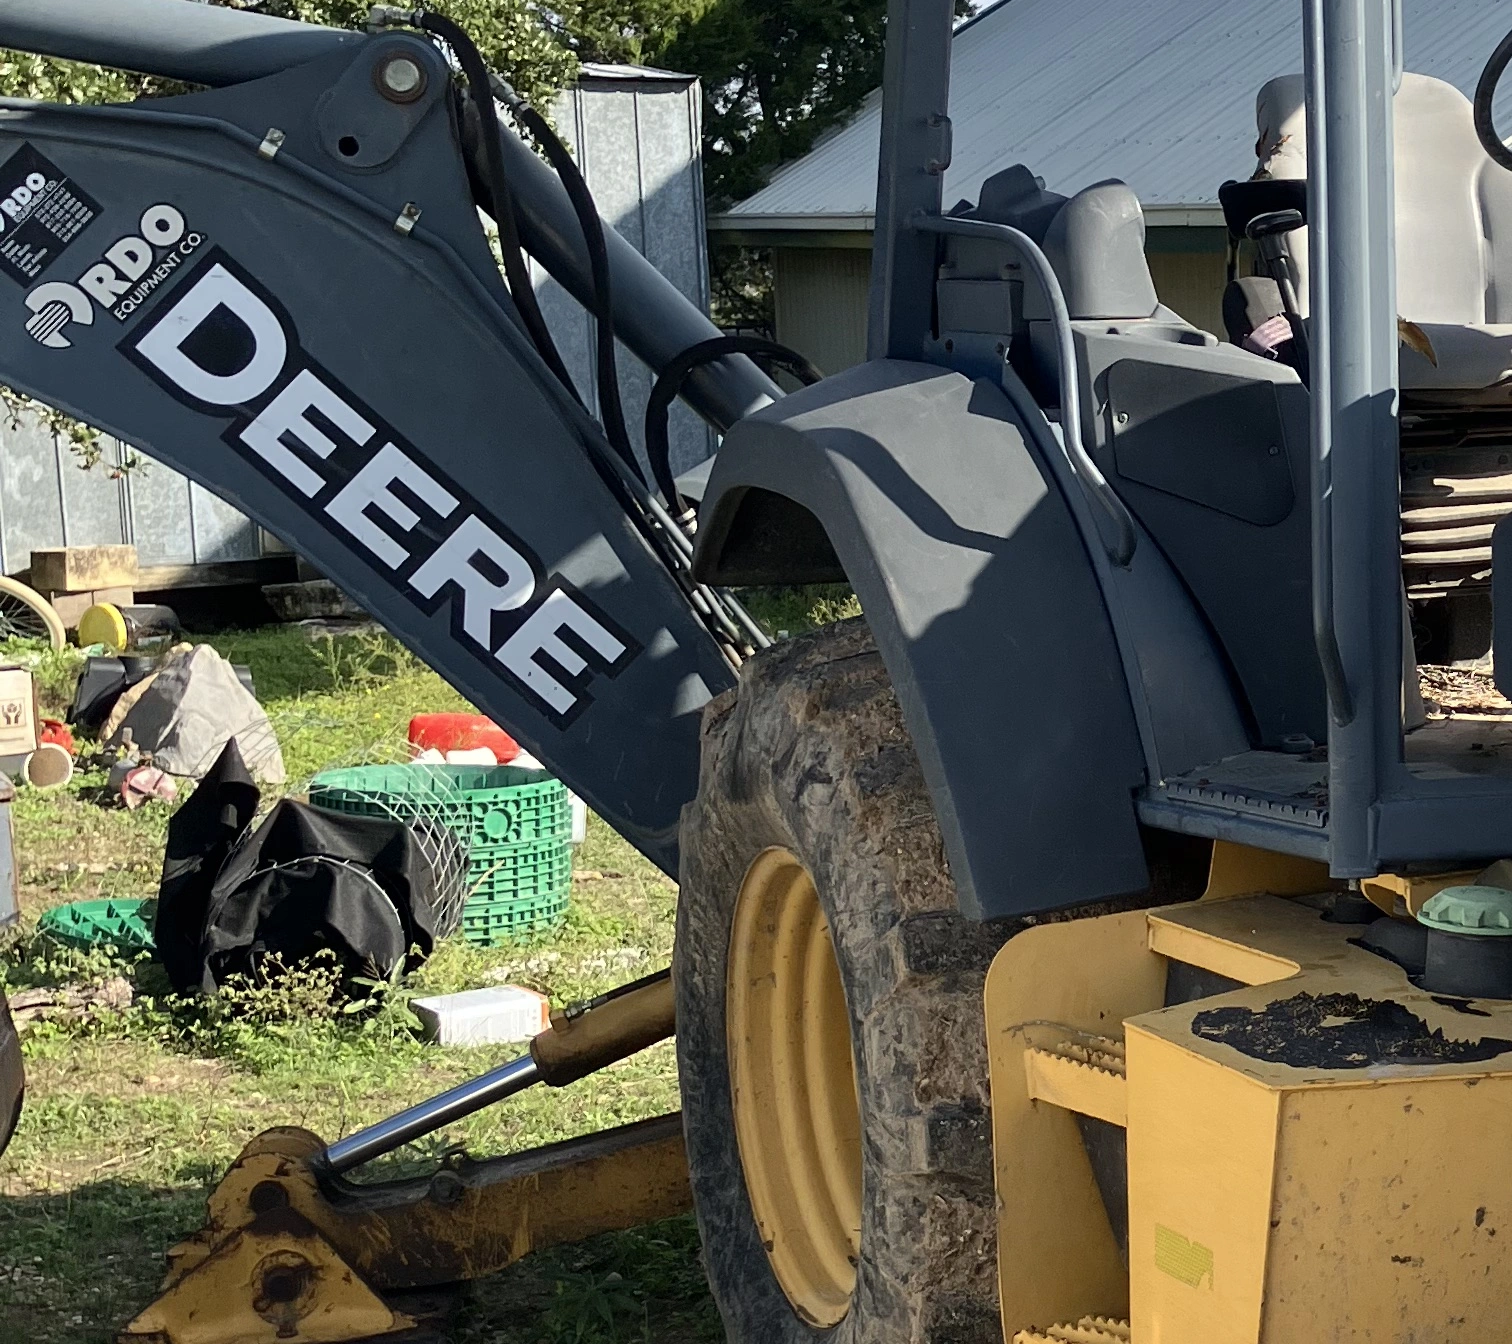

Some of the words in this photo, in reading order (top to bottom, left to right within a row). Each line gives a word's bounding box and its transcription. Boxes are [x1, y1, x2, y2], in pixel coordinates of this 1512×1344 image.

[0, 172, 46, 217] RDO
[78, 204, 185, 308] RDO
[113, 251, 182, 321] EQUIPMENT
[134, 261, 628, 717] DEERE
